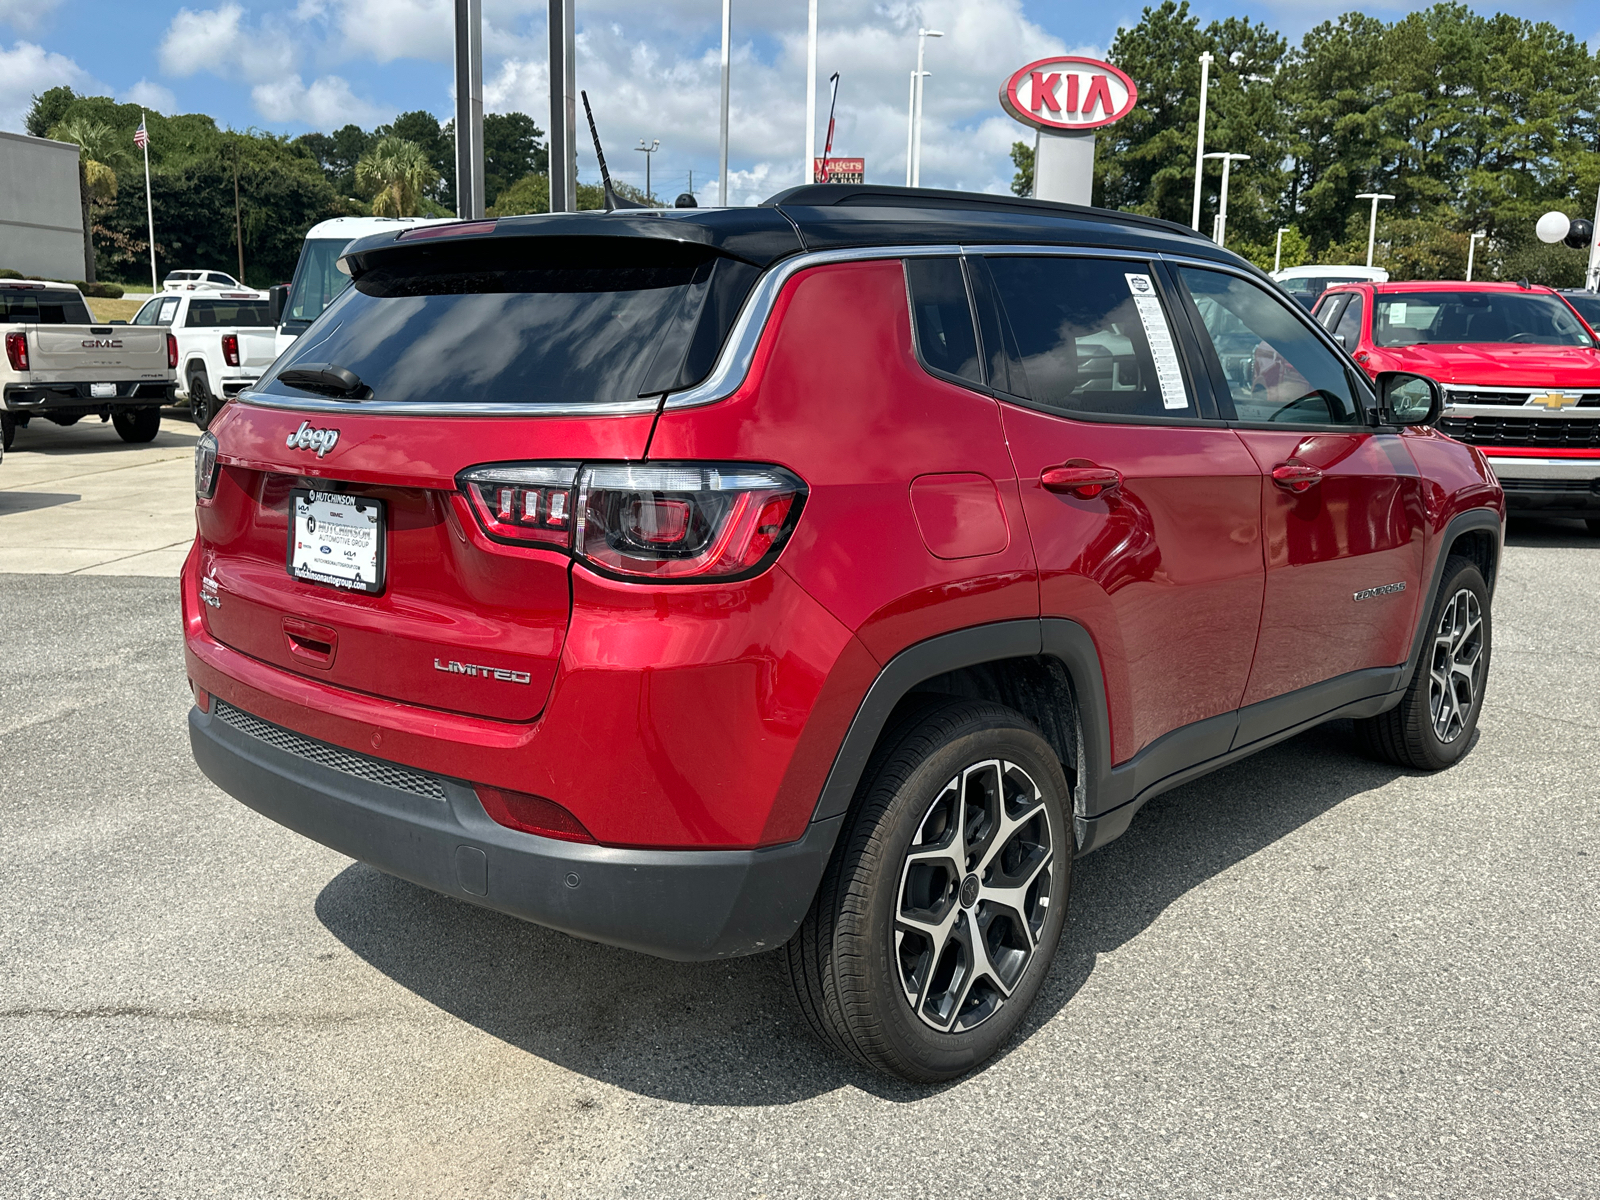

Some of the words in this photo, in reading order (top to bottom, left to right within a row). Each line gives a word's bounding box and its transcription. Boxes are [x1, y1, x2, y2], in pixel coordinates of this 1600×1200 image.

[1030, 72, 1115, 114] KIA
[81, 340, 123, 348] GMC
[285, 420, 340, 458] Jeep
[315, 491, 356, 506] HUTCHINSON
[318, 534, 350, 545] AUTOMOTIVE
[351, 538, 369, 548] GROUP
[1353, 581, 1406, 601] COMPASS
[434, 658, 531, 684] LIMITED
